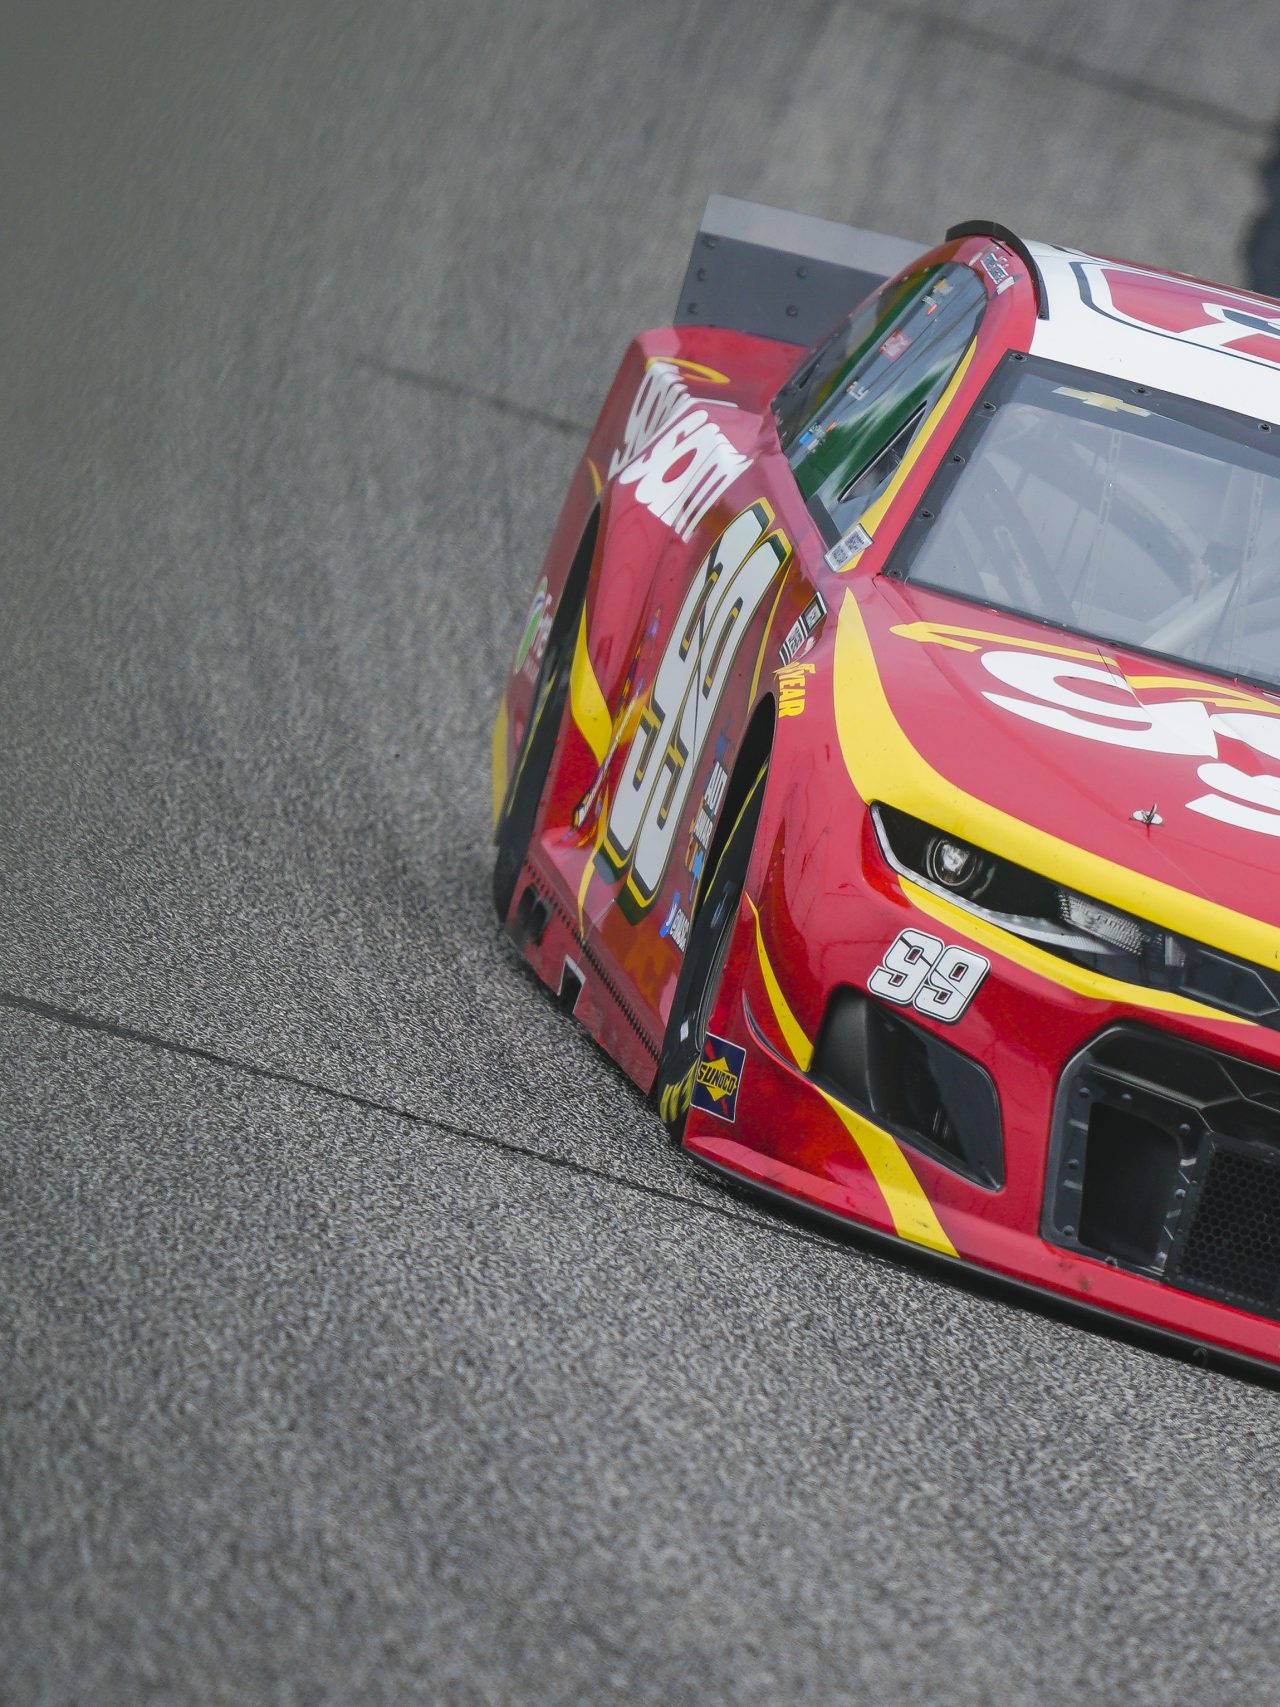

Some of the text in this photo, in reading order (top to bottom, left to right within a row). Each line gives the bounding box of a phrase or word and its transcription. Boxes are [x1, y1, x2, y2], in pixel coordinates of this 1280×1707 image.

[604, 497, 790, 908] 99
[868, 928, 991, 1023] 99
[698, 1062, 737, 1095] SUNOCO
